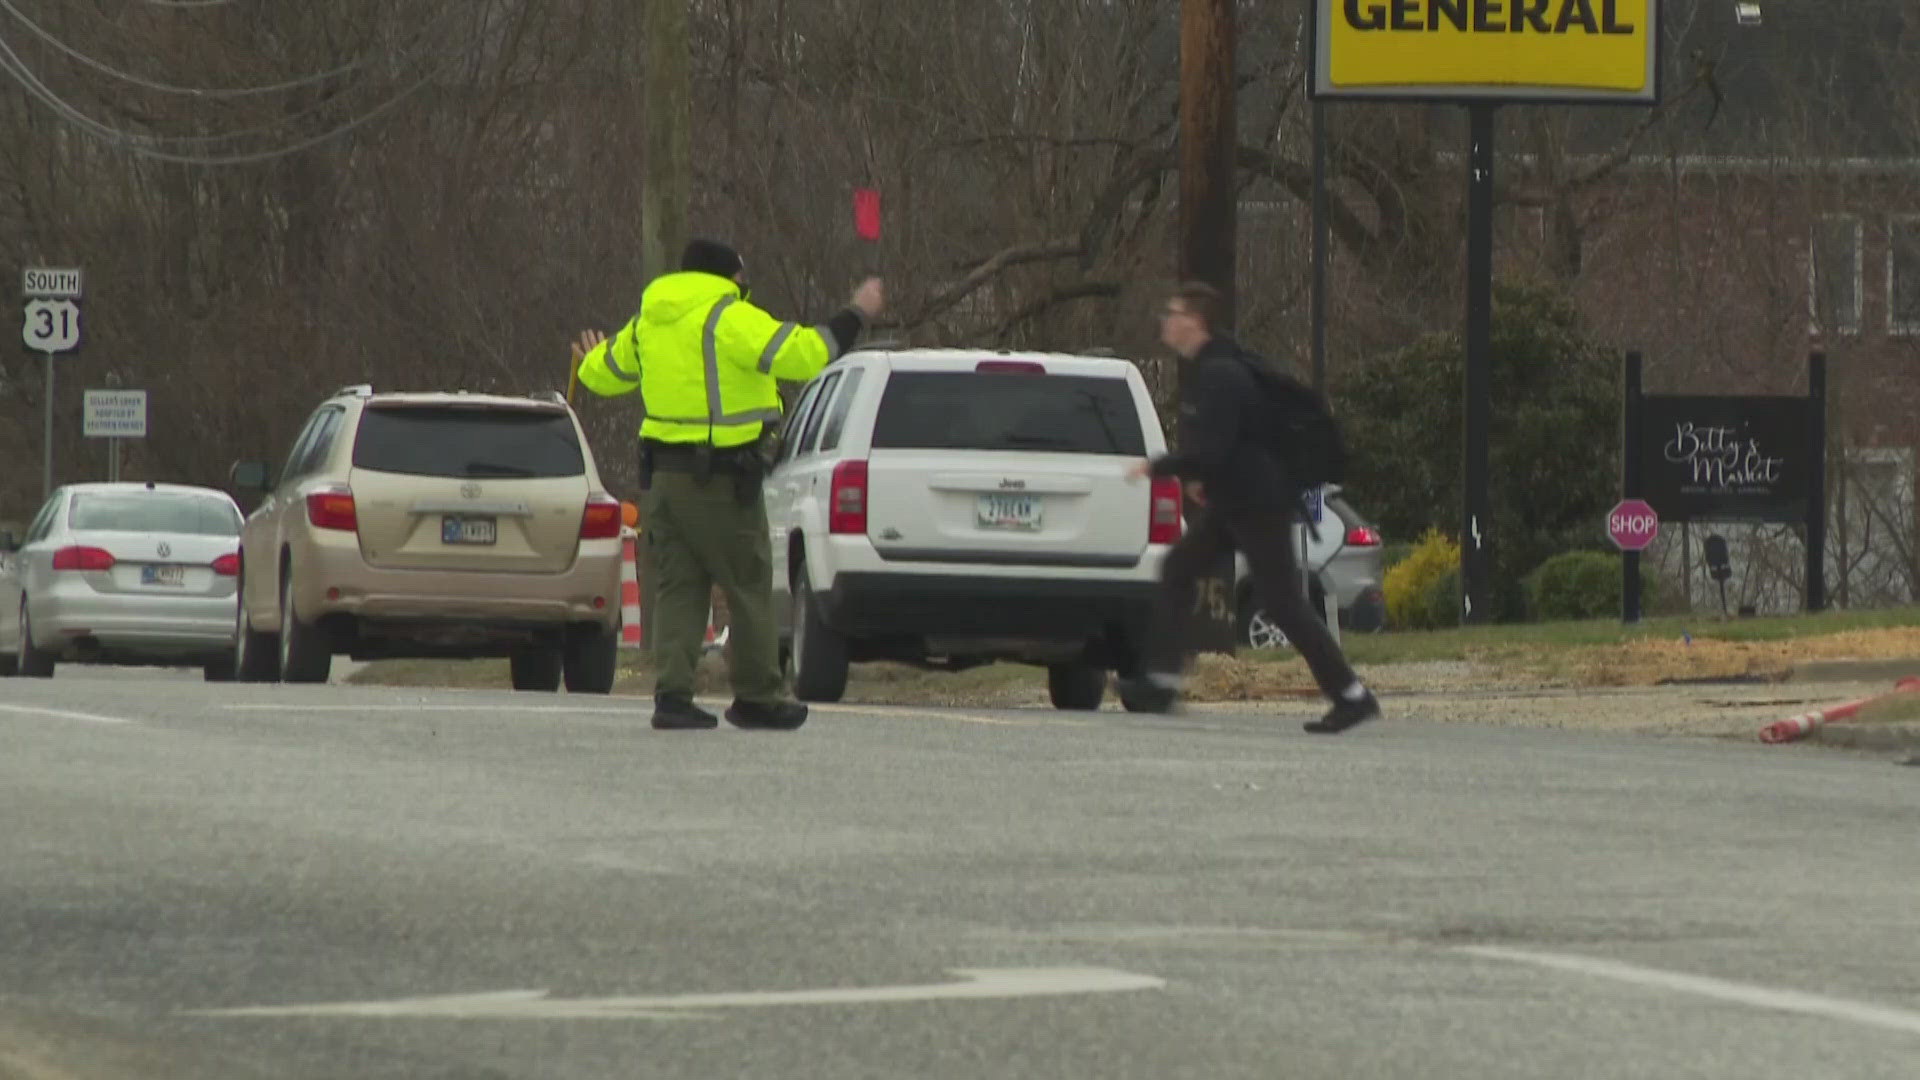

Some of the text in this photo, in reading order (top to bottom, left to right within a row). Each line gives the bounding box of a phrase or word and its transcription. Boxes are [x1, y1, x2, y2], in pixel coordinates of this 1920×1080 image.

[1343, 0, 1634, 34] GENERAL
[27, 271, 77, 291] SOUTH
[34, 308, 69, 340] 31
[1664, 420, 1759, 469] Betty's
[999, 477, 1026, 489] Jeep
[1688, 453, 1783, 487] Market
[1611, 514, 1654, 534] SHOP
